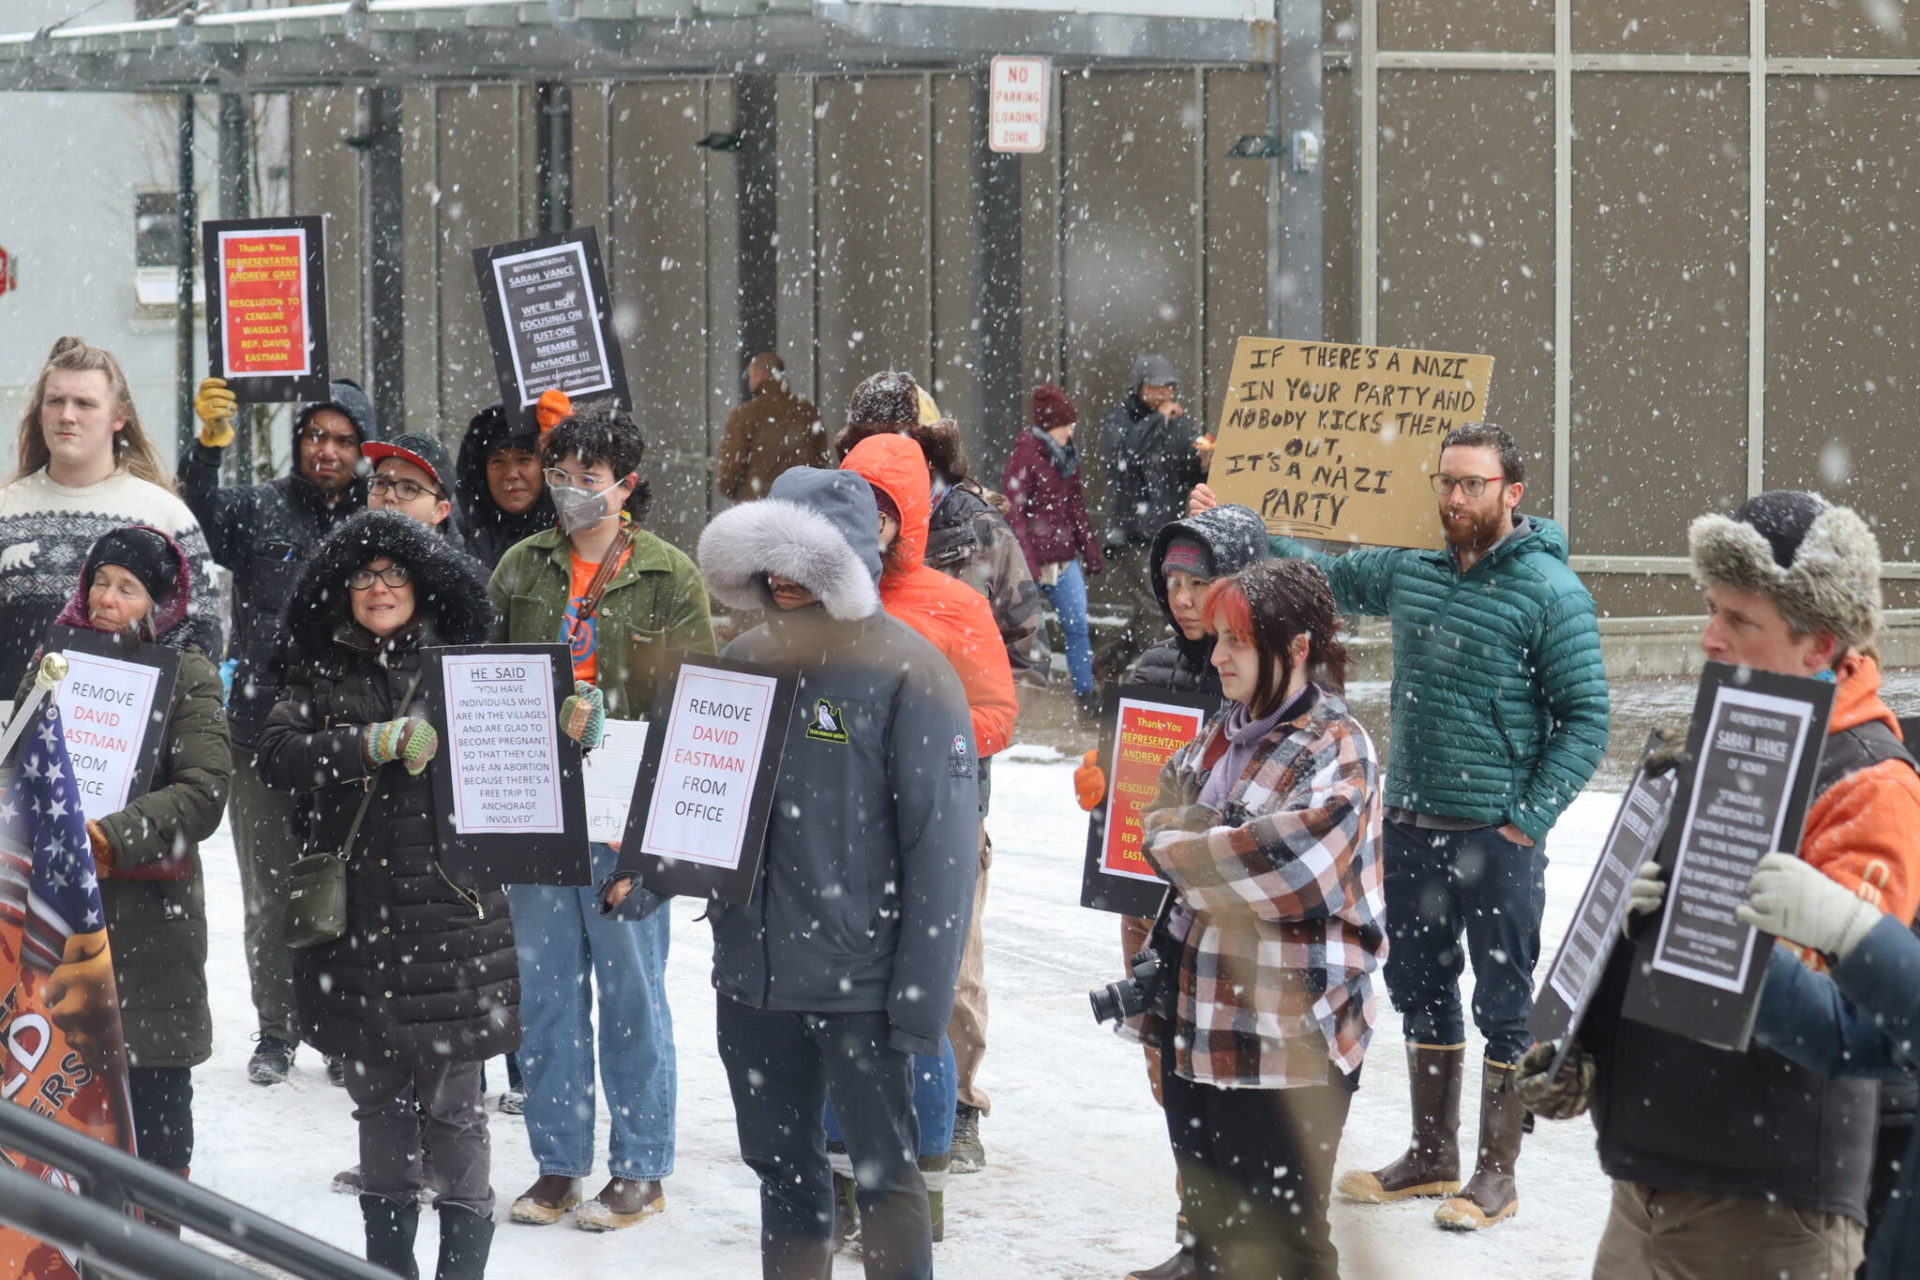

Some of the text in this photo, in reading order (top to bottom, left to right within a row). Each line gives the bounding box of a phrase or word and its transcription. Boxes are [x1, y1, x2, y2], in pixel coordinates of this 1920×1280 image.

[1008, 67, 1028, 83] NO
[996, 91, 1039, 103] PARKING
[995, 112, 1039, 123] LOADING
[1004, 131, 1029, 143] ZONE
[239, 244, 264, 252] Thank
[227, 257, 298, 267] REPRESENTATIVE
[513, 256, 566, 273] REPRESENTATIVE
[230, 272, 268, 280] ANDREW
[509, 265, 574, 286] SARAH VANCE
[538, 281, 562, 291] HOMER
[230, 298, 282, 307] RESOLUTION
[521, 297, 574, 315] WE'RE NOT
[245, 312, 284, 320] CENSURE
[519, 310, 583, 330] FOCUSING ON
[243, 326, 288, 334] WASILLA'S
[533, 326, 575, 342] JUST ONE
[537, 340, 577, 355] MEMBER
[530, 354, 577, 371] ANYMORE
[1251, 346, 1468, 379] IF THERE'S A NAZI
[525, 376, 550, 386] REMOVE
[583, 365, 601, 373] FROM
[1240, 378, 1475, 412] IN YOUR PARTY AND
[1318, 410, 1384, 434] KICKS
[1396, 412, 1451, 437] THEM
[1284, 438, 1343, 464] OUT,
[1226, 452, 1392, 494] IT'S A NAZI
[1261, 488, 1349, 526] PARTY
[471, 667, 525, 680] HE SAID
[72, 682, 135, 706] REMOVE
[500, 685, 524, 693] HAVE
[459, 698, 541, 707] INDIVIDUALS WHO
[689, 699, 753, 722] REMOVE
[74, 706, 120, 727] DAVID
[456, 711, 547, 720] ARE IN THE VILLAGES
[463, 724, 543, 734] AND ARE GLAD TO
[1137, 717, 1182, 733] Thank You
[63, 727, 128, 753] ASTMAN
[458, 737, 496, 747] BECOME
[692, 725, 738, 745] DAVID
[1122, 732, 1190, 750] REPRESENTATIV
[1716, 729, 1788, 757] SARAH VANCE
[67, 751, 108, 773] ROM
[463, 750, 546, 759] SO THAT THEY CAN
[674, 748, 745, 773] EASTMAN
[1122, 749, 1161, 763] ANDREW
[462, 763, 549, 772] HAVE AN ABORTION
[464, 776, 549, 785] BECAUSE THERE'S A
[682, 776, 727, 796] FROM
[1117, 781, 1160, 796] RESOLUTI
[480, 789, 537, 798] FREE TRIP TO
[481, 801, 537, 811] ANCHORAGE
[675, 801, 724, 822] OFFICE
[1121, 832, 1140, 844] REP.
